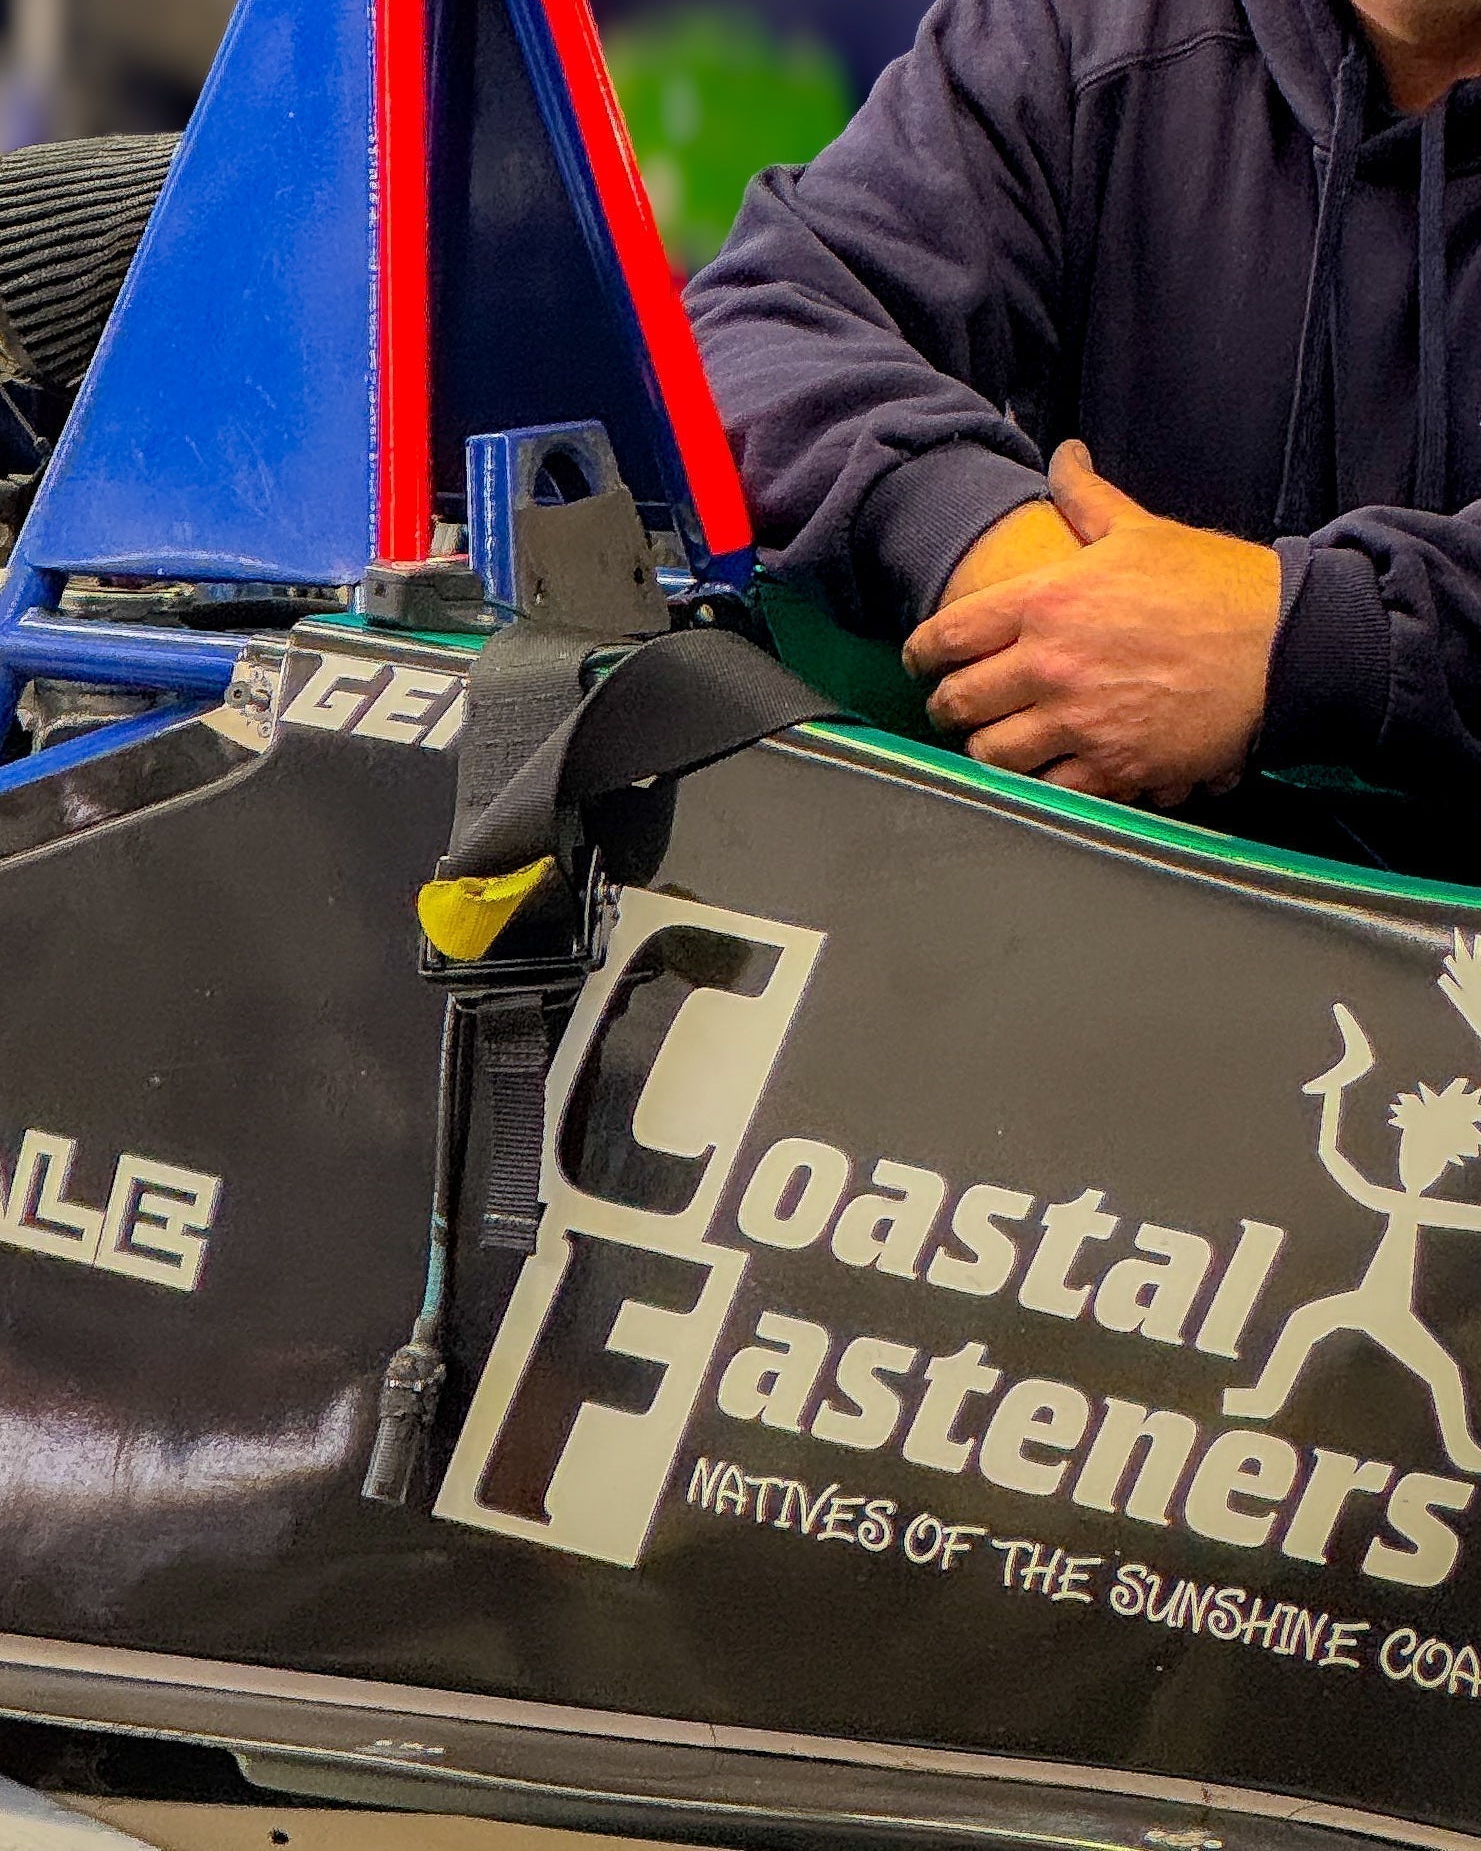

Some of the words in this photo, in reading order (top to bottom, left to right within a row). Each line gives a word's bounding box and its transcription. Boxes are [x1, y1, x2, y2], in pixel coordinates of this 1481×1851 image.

[539, 886, 1286, 1359] Coastal
[433, 1230, 1475, 1588] Fasteners
[686, 1457, 893, 1553] NATIVES
[903, 1514, 988, 1572] OF
[992, 1539, 1104, 1605] THE
[1110, 1563, 1369, 1669] SUNSHINE
